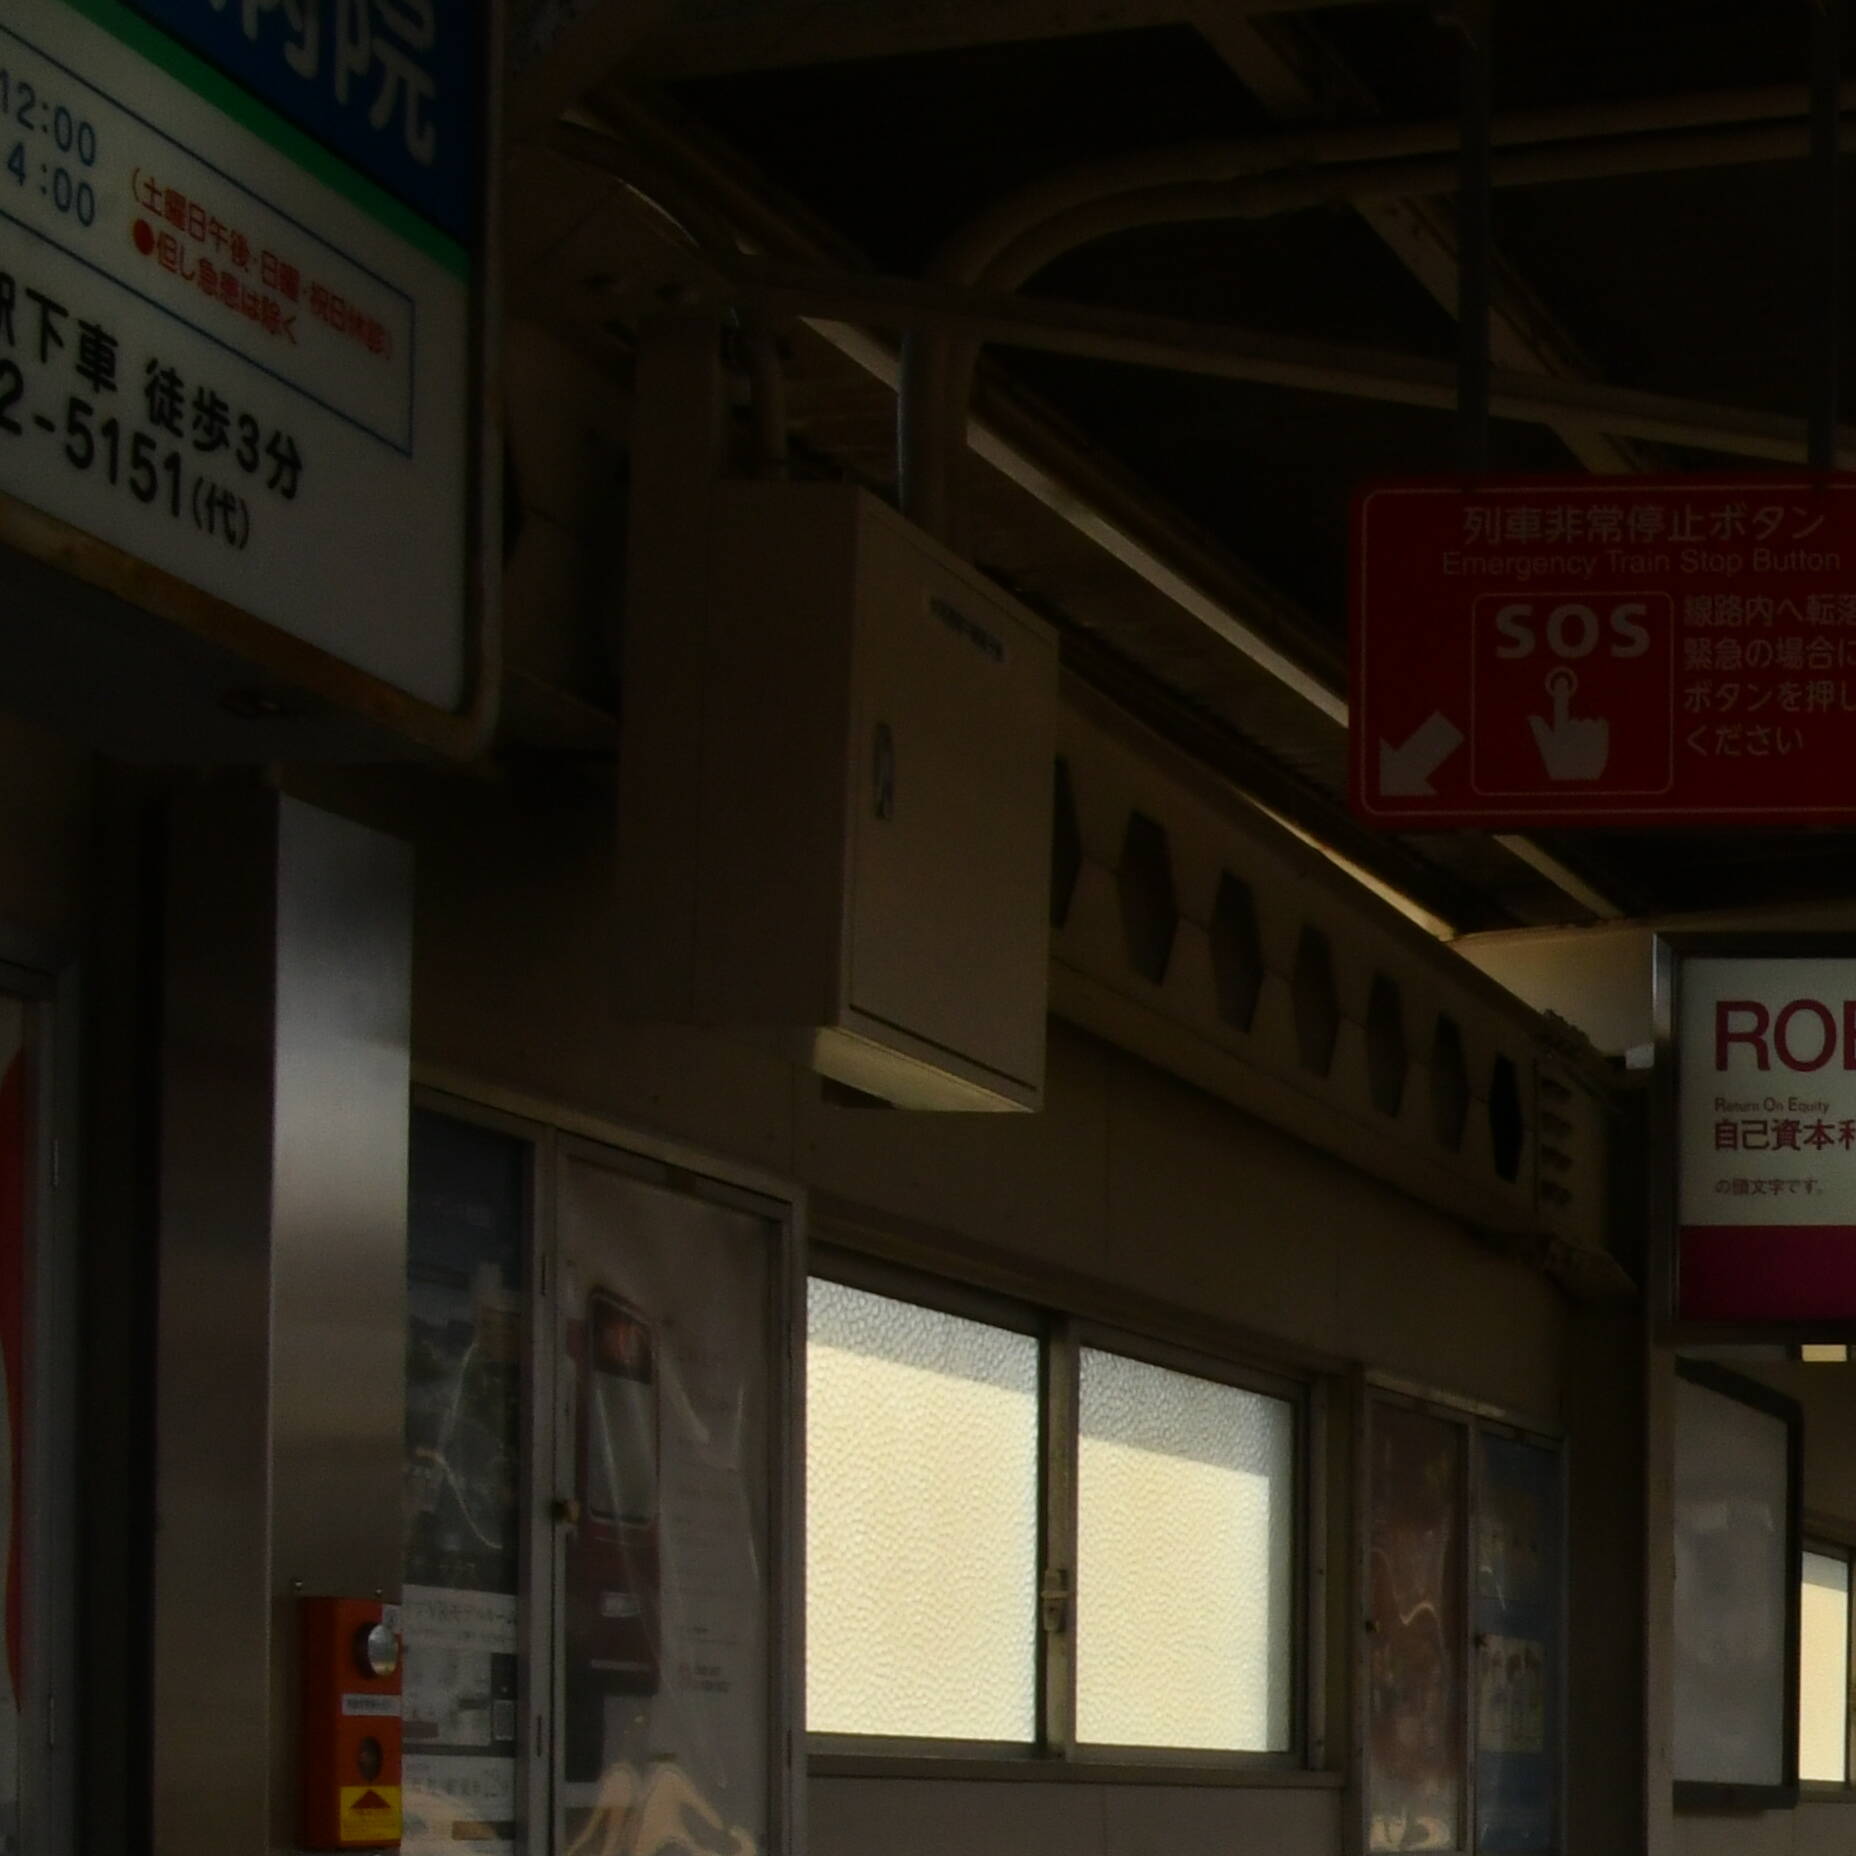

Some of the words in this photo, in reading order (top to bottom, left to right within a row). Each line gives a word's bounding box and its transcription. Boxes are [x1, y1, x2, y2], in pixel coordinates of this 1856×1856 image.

[0, 68, 97, 167] 12:00
[8, 142, 96, 227] 4:00
[145, 358, 302, 500] 徒歩3分
[1463, 503, 1826, 545] 列車非常停止ボタン
[1442, 550, 1599, 581] Emergency
[1607, 550, 1670, 574] Train
[1680, 549, 1743, 577] Stop
[1753, 548, 1841, 572] Button
[1494, 602, 1652, 660] SOS
[1685, 725, 1808, 758] ください
[1715, 1097, 1760, 1113] Return
[1764, 1097, 1785, 1113] On
[1788, 1097, 1830, 1115] Equity
